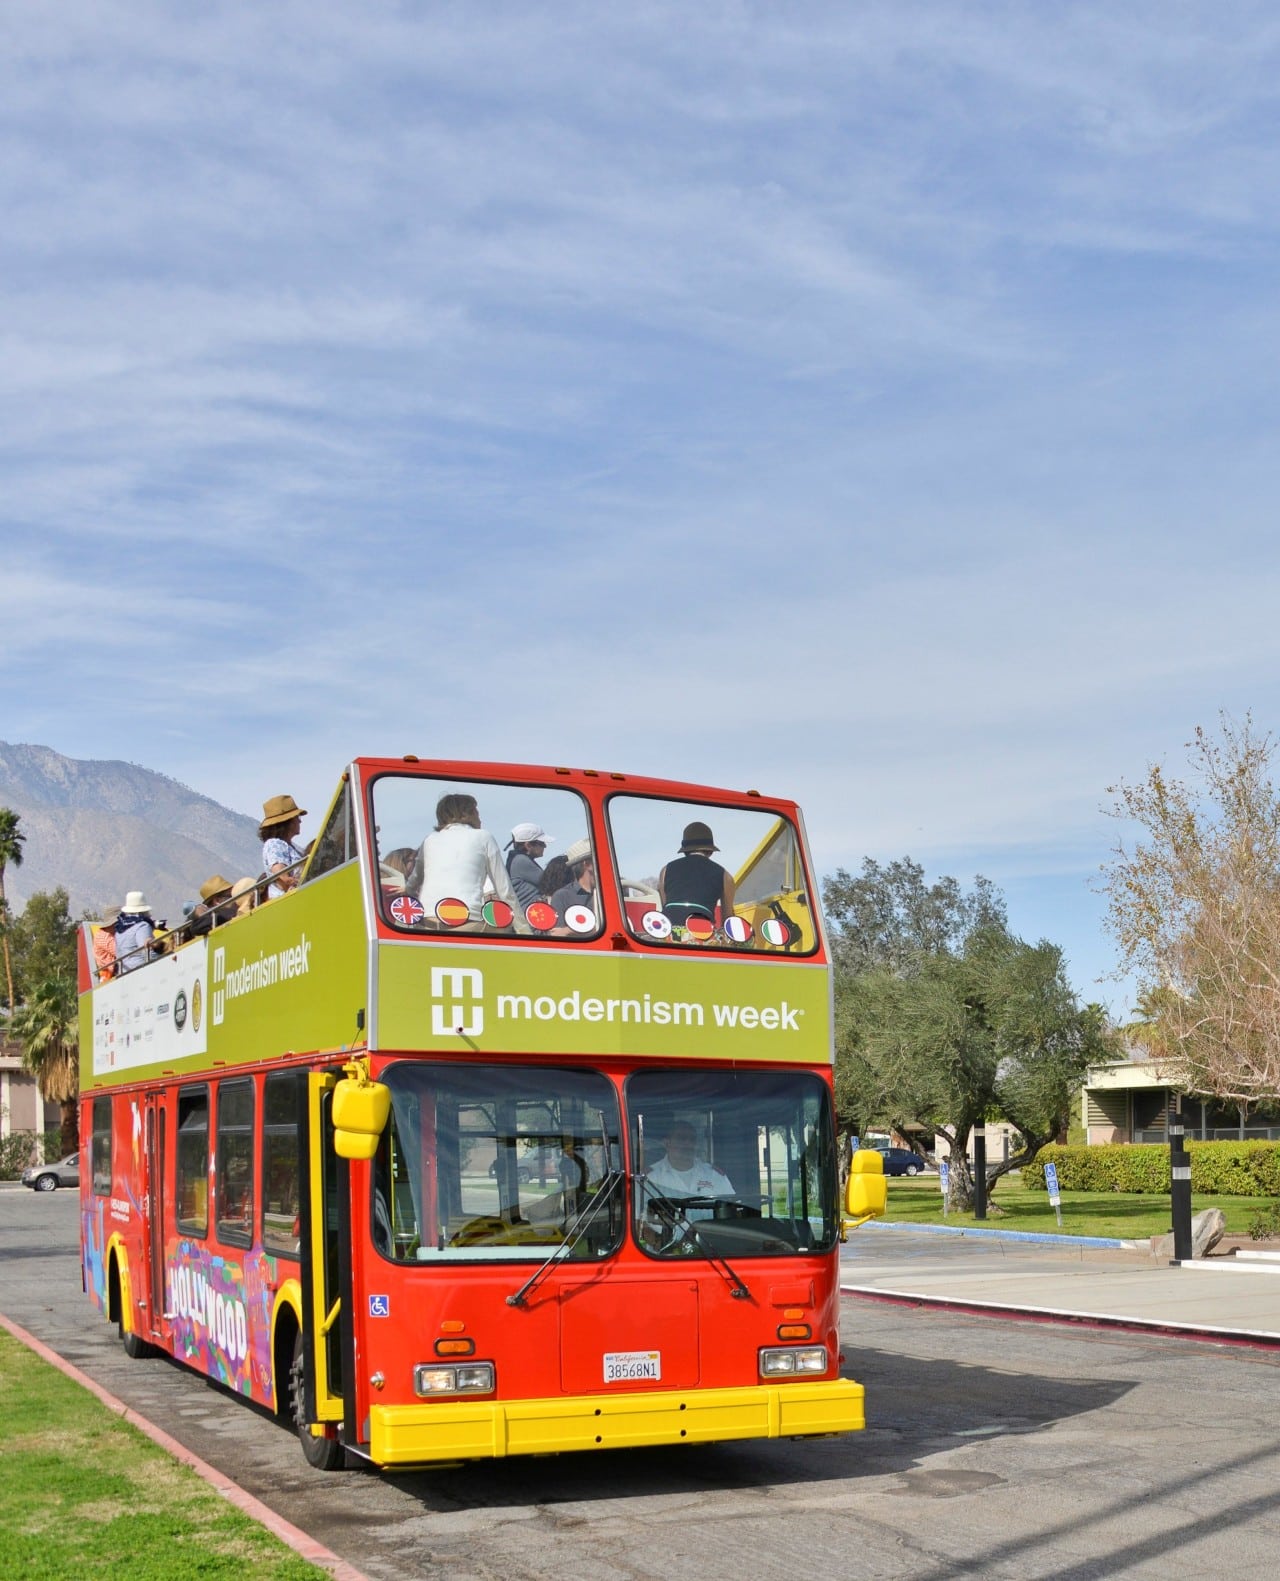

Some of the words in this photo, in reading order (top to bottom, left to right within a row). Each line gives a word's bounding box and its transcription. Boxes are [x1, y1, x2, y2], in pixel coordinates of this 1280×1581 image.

[226, 950, 278, 1001] modernism
[496, 990, 705, 1027] modernism
[169, 1264, 248, 1361] HOLLYWOOD
[607, 1361, 657, 1379] 38568N1
